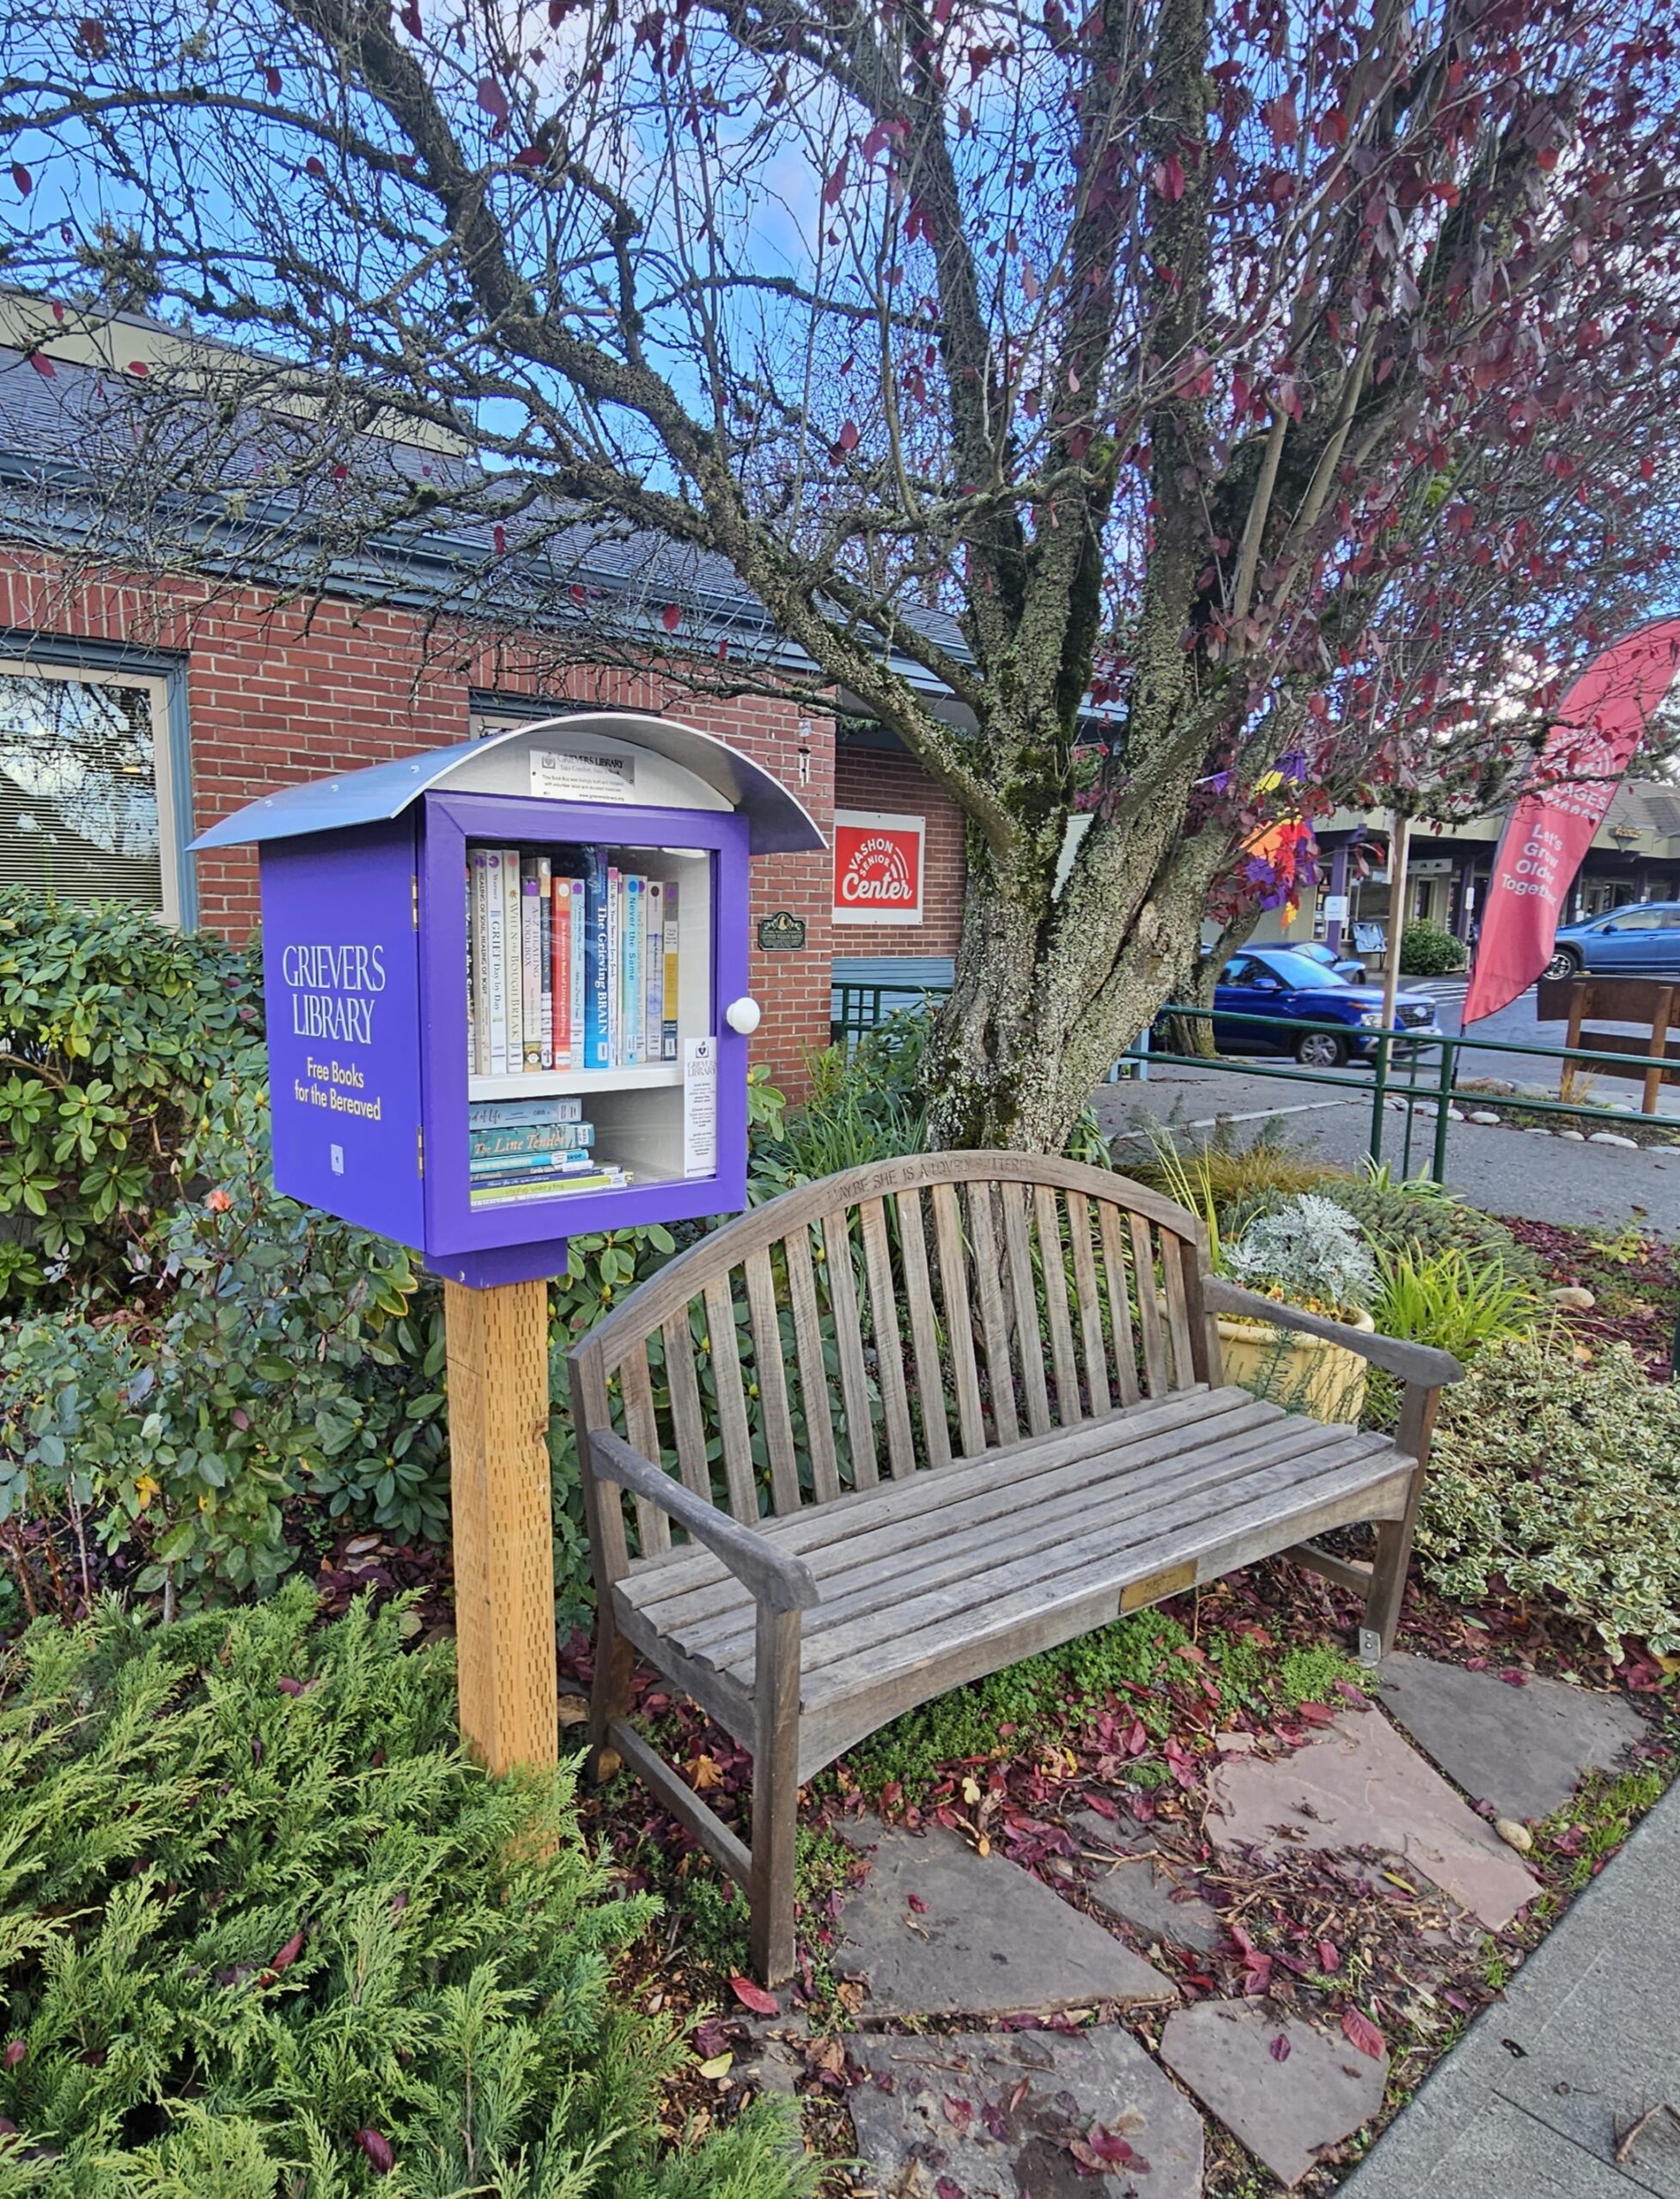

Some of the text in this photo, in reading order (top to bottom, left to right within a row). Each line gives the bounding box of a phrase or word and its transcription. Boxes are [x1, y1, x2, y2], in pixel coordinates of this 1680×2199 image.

[557, 754, 624, 769] GRIEVERS LIBRARY
[1531, 823, 1563, 851] Let's
[849, 838, 893, 870] VASHON
[860, 854, 890, 877] SENIOR
[1524, 841, 1559, 868] Grow
[842, 871, 913, 901] Center
[597, 905, 607, 929] The
[491, 921, 502, 961] GRIEF
[283, 945, 386, 991] GRIEVERS
[492, 964, 502, 979] Day
[594, 932, 608, 989] Grieving
[628, 953, 636, 981] Same
[493, 982, 502, 992] by
[510, 955, 520, 996] BOUGH
[292, 993, 375, 1045] LIBRARY
[597, 991, 607, 1035] BRAIN
[307, 1057, 364, 1088] Free Books
[295, 1079, 380, 1121] for the Bereaved
[475, 1134, 564, 1154] The Line Tender
[873, 1169, 897, 1189] SHE
[902, 1167, 915, 1181] IS
[920, 1163, 928, 1179] A
